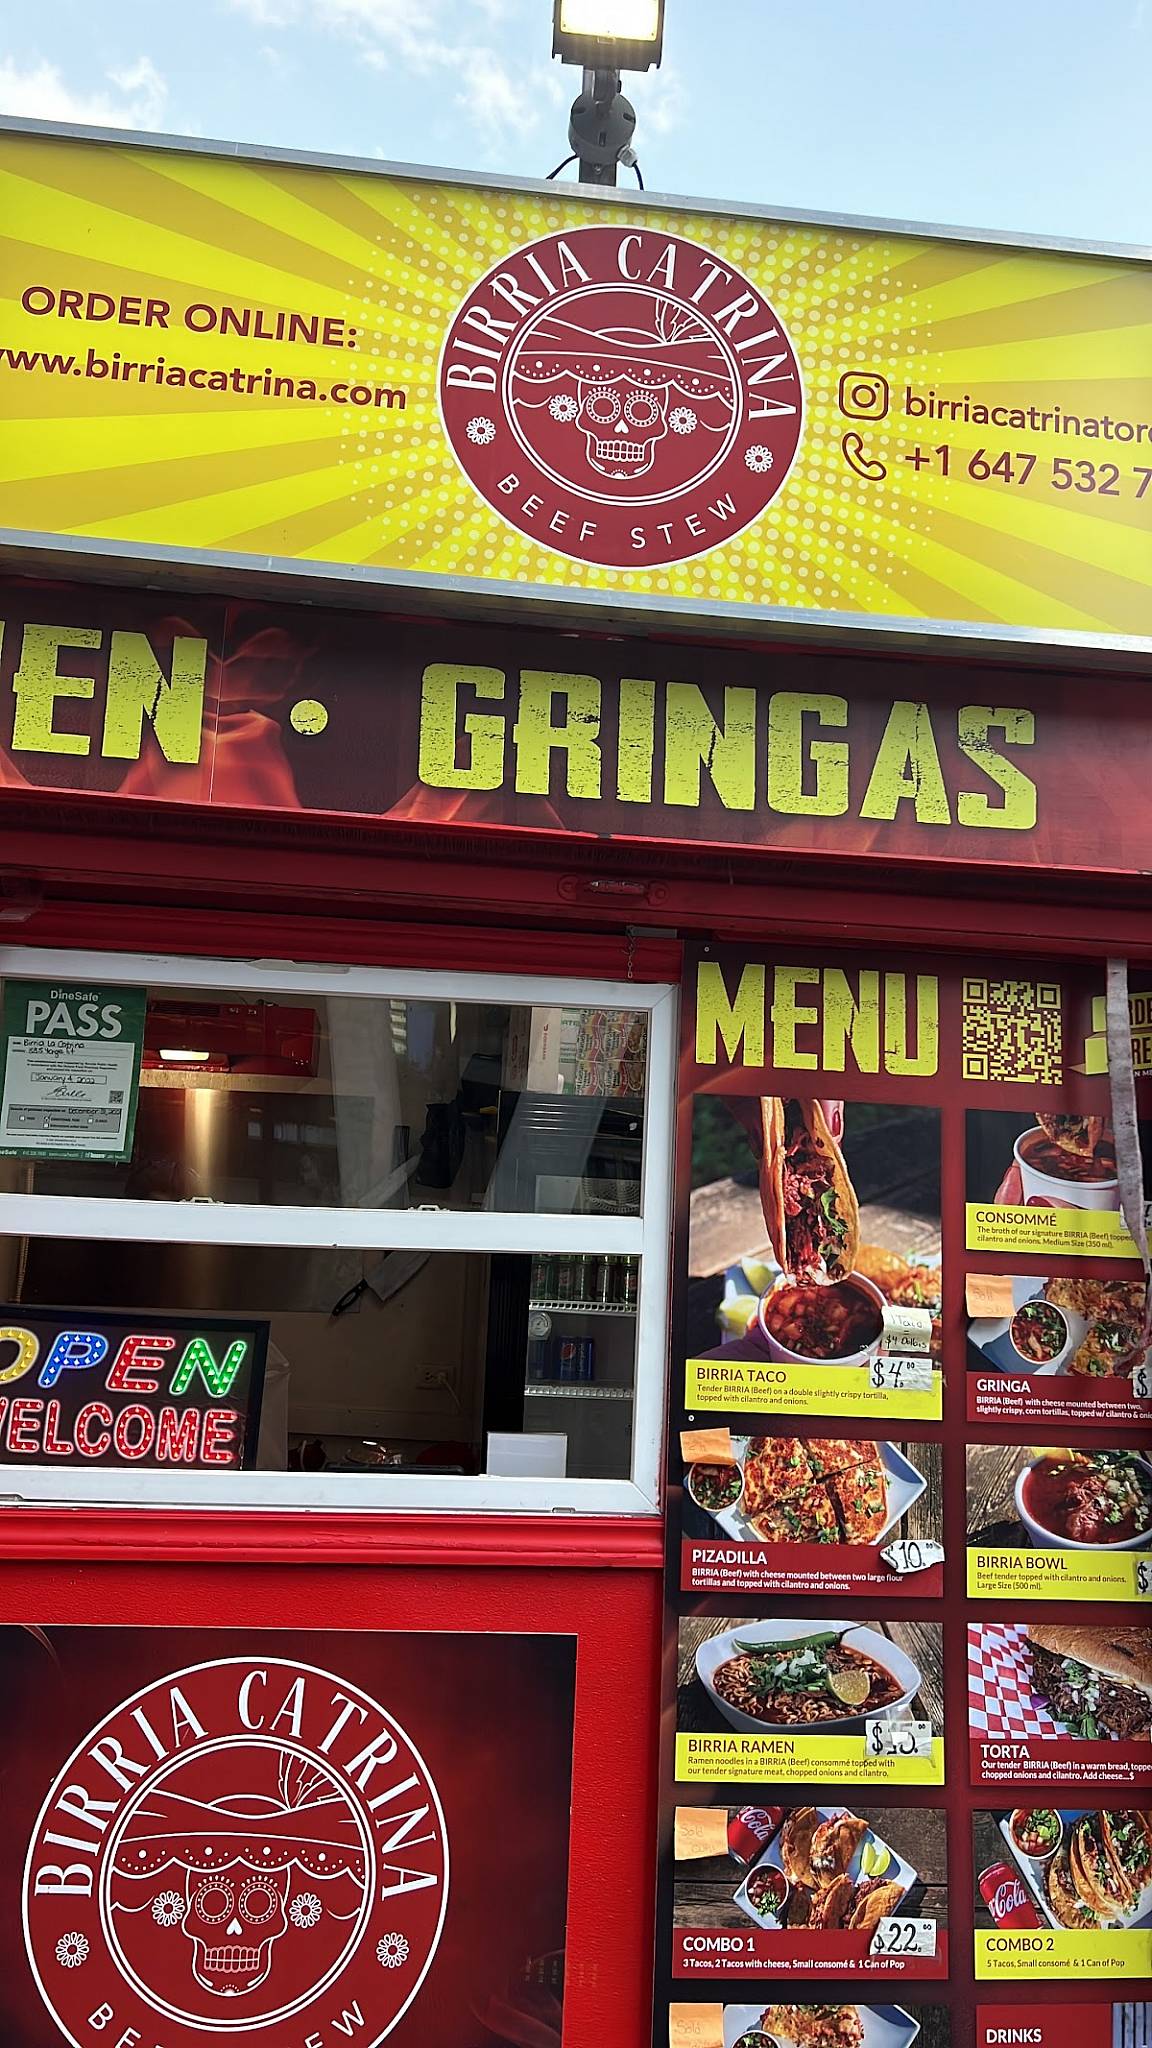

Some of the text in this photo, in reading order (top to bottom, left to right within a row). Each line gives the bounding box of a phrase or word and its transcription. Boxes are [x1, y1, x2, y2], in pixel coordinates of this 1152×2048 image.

[21, 285, 358, 348] ORDER ONLINE:
[446, 231, 796, 421] BIRRIA CATRINA
[905, 445, 950, 477] +1
[968, 449, 1036, 485] 647
[1051, 457, 1121, 497] 532
[497, 473, 736, 549] BEEF STEW
[0, 620, 208, 764] EN
[418, 662, 1037, 830] GRINGAS
[50, 989, 99, 1002] DineSafe
[26, 1000, 122, 1038] PASS
[695, 961, 938, 1077] MENU
[976, 1211, 1057, 1227] CONSOMMÉ
[977, 1235, 1004, 1243] cilantro
[1042, 1238, 1071, 1246] Medium
[991, 1227, 1010, 1235] broth
[1032, 1229, 1062, 1238] signature
[1064, 1231, 1089, 1239] BIRRIA
[1089, 1232, 1109, 1241] (Beef)
[0, 1327, 246, 1398] OPEN
[697, 1367, 787, 1383] BIRRIA TACO
[697, 1384, 723, 1392] Tender
[724, 1385, 750, 1393] BIRRIA
[751, 1387, 772, 1396] (Beef)
[789, 1388, 813, 1397] double
[814, 1389, 840, 1399] slightly
[840, 1391, 862, 1399] crispy
[976, 1378, 1031, 1393] GRINGA
[697, 1394, 722, 1403] topped
[741, 1396, 768, 1404] cilantro
[976, 1396, 1127, 1409] BIRRIA (Beef) with cheese mounted between
[976, 1405, 1002, 1415] slightly
[1071, 1409, 1095, 1418] topped
[1106, 1410, 1132, 1419] cilantro
[0, 1396, 239, 1463] ELCOME
[692, 1549, 768, 1565] PIZADILLA
[977, 1555, 1068, 1570] BIRRIA BOWL
[692, 1567, 904, 1582] BIRRIA (Beef) with cheese mounted between two large flour
[977, 1572, 994, 1580] Beef
[994, 1573, 1018, 1581] tender
[1018, 1573, 1043, 1582] topped
[1043, 1573, 1060, 1581] with
[1060, 1574, 1088, 1582] cilantro
[692, 1578, 851, 1590] tortillas and topped with cilantro and onions.
[977, 1582, 997, 1590] Large
[1012, 1582, 1029, 1590] (500
[688, 1739, 795, 1754] BIRRIA RAMEN
[980, 1744, 1031, 1759] TORTA
[688, 1756, 714, 1765] Ramen
[715, 1757, 745, 1765] noodles
[760, 1757, 787, 1766] BIRRIA
[788, 1757, 810, 1767] (Beef)
[811, 1758, 851, 1767] consommé
[851, 1759, 877, 1769] topped
[981, 1760, 1131, 1772] Our tender BIRRIA (Beef) warm bread,
[702, 1767, 728, 1775] tender
[728, 1768, 763, 1776] signature
[785, 1768, 818, 1778] chopped
[818, 1769, 844, 1777] onions
[844, 1769, 858, 1777] and
[859, 1769, 889, 1777] cilantro.
[981, 1770, 1098, 1780] chopped onions and cilantro. Add
[34, 1670, 439, 1901] BIRRIA CATRINA
[683, 1936, 756, 1952] COMBO 1
[986, 1937, 1055, 1952] COMBO 2
[689, 1958, 906, 1969] Tacos, Tacos with cheese, Small consomé Can Pop
[993, 1959, 1125, 1969] Tacos, Small consomé Can Pop
[986, 2028, 1042, 2044] DRINKS
